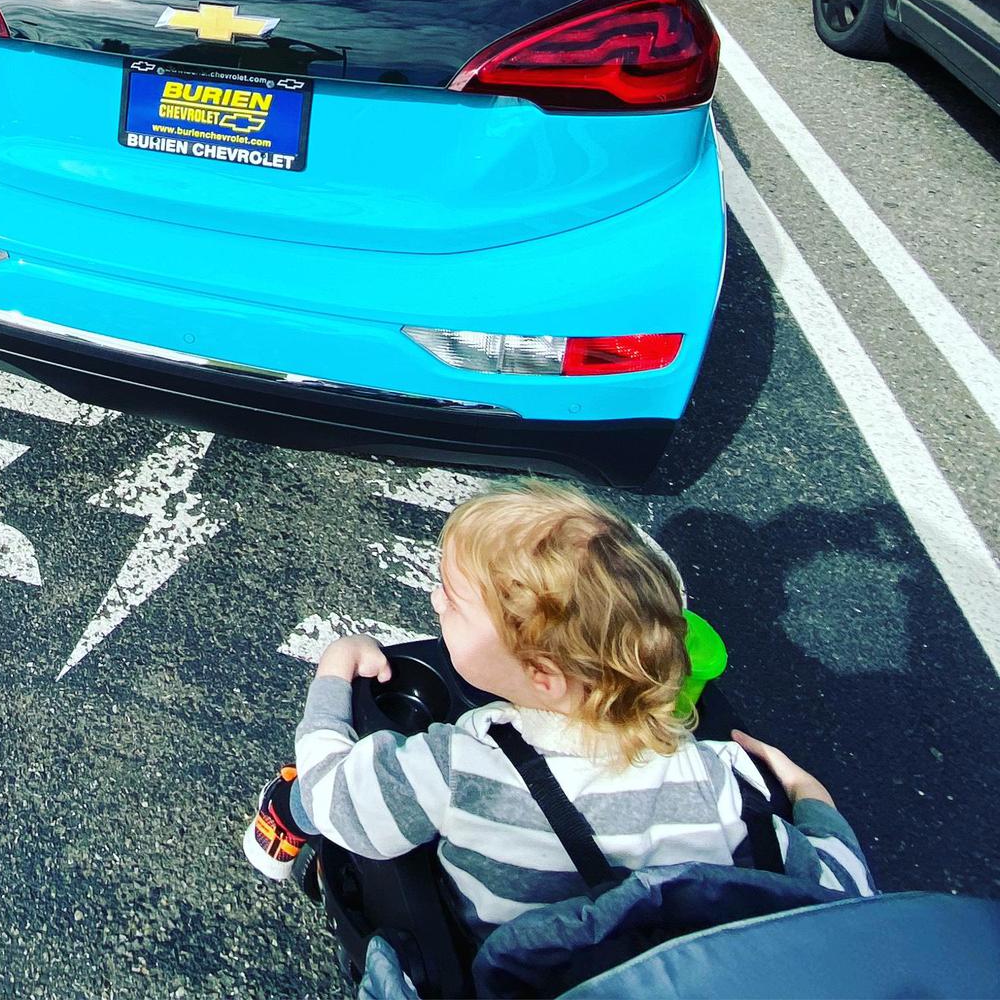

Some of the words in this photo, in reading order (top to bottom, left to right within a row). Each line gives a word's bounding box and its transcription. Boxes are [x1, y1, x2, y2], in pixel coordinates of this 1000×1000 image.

[162, 81, 273, 111] BURIEN
[159, 104, 220, 125] CHEVROLET
[152, 124, 272, 147] www.burienchevrolet.com
[127, 133, 189, 155] BURIEN
[192, 142, 296, 170] CHEVROLET
